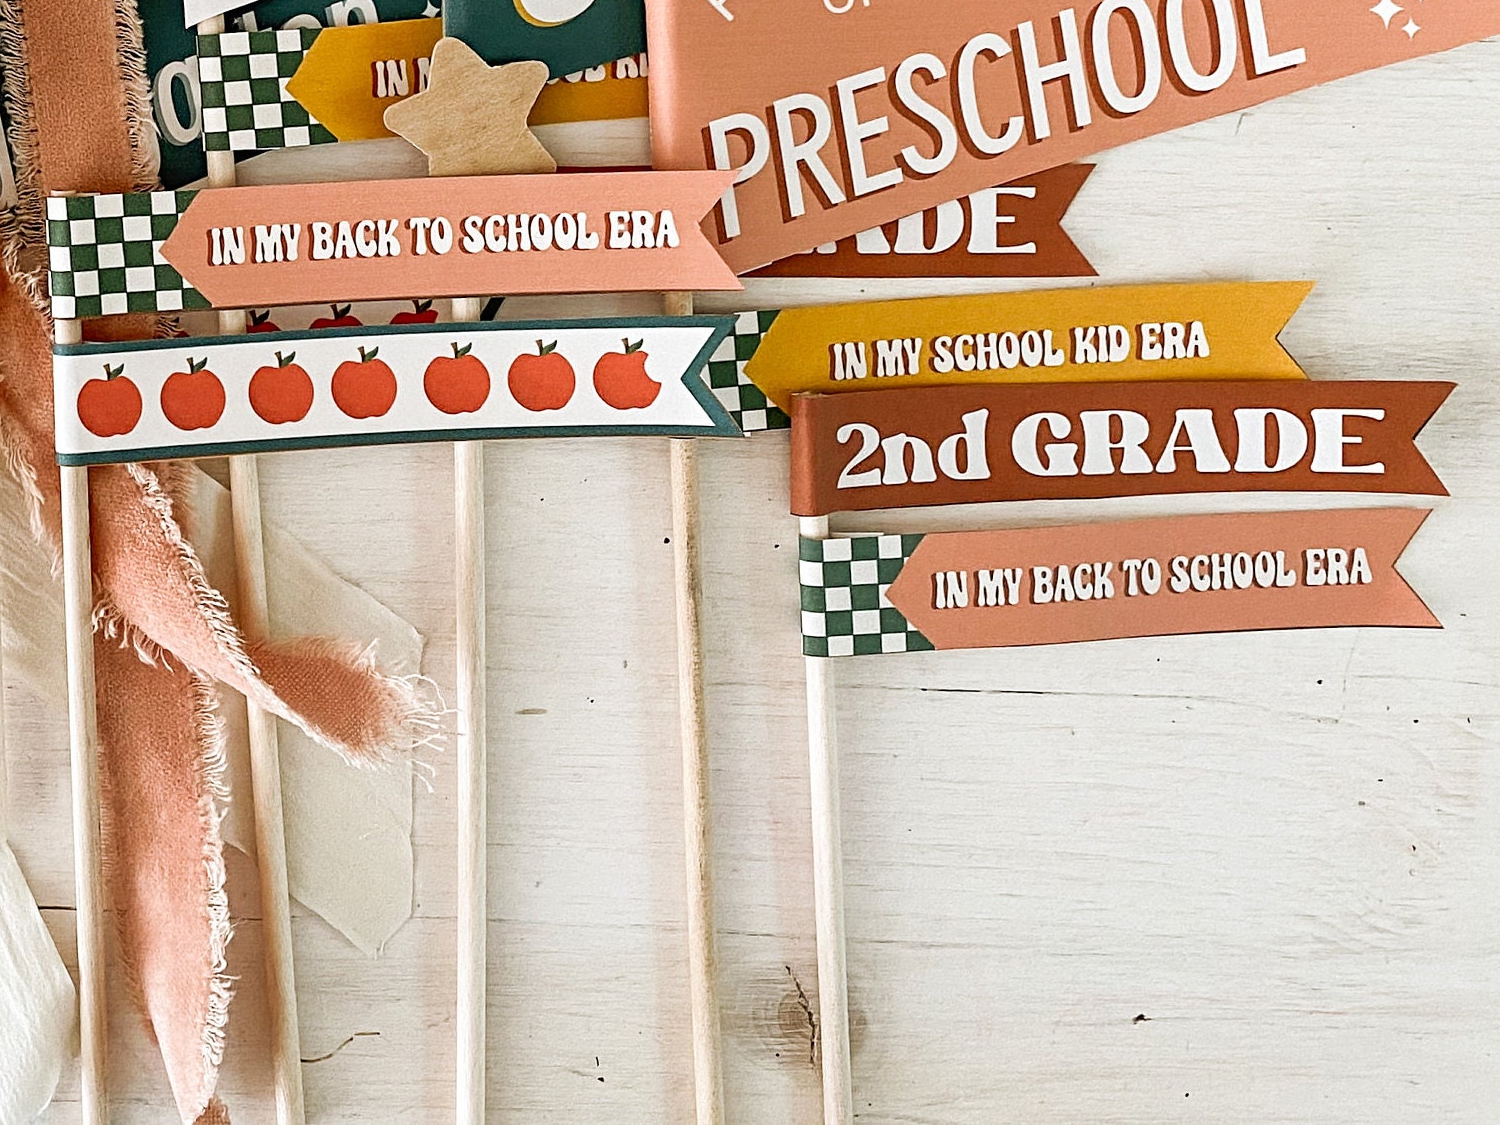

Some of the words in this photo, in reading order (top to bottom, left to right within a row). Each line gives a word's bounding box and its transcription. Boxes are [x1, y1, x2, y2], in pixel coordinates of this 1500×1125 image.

[371, 59, 409, 97] IN
[206, 226, 245, 266] IN
[251, 224, 301, 263] MY
[308, 219, 400, 261] BACK
[407, 216, 453, 256] TO
[459, 212, 599, 254] SCHOOL
[605, 210, 680, 250] ERA
[829, 341, 867, 381] IN
[875, 338, 922, 377] MY
[931, 329, 1064, 375] SCHOOL
[1070, 324, 1130, 365] KID
[1137, 320, 1211, 362] ERA
[835, 407, 991, 489] 2nd
[1011, 407, 1386, 475] GRADE
[931, 571, 969, 610] IN
[976, 567, 1022, 607] MY
[1031, 561, 1113, 605] BACK
[1121, 557, 1162, 599] TO
[1168, 551, 1296, 594] SCHOOL
[1304, 547, 1373, 588] ERA
